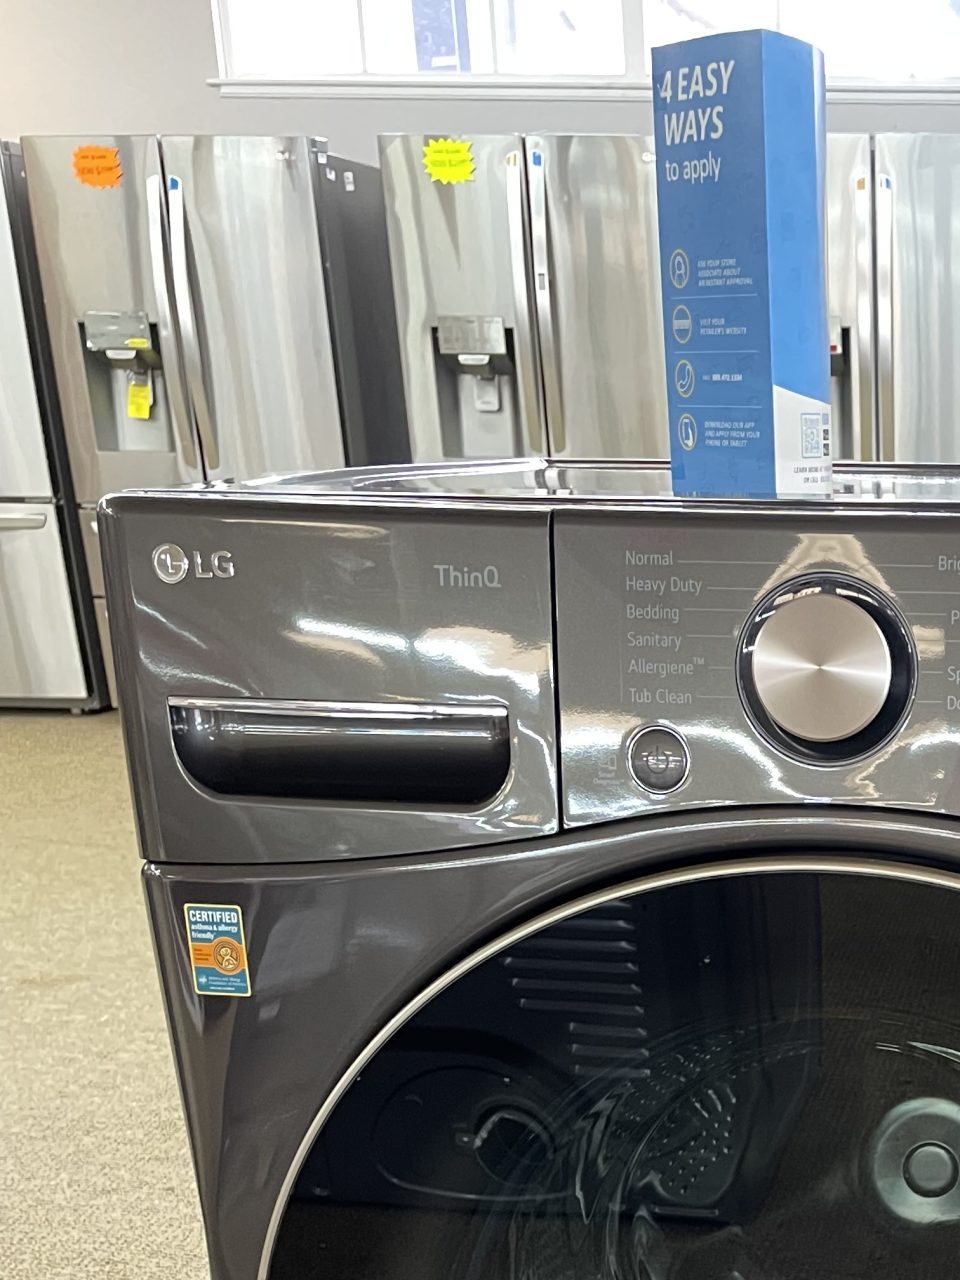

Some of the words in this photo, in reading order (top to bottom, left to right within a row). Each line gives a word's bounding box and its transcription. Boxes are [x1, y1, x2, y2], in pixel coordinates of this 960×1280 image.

[658, 70, 672, 103] 4
[678, 60, 735, 101] EASY
[664, 106, 724, 146] WAYS
[666, 160, 679, 182] to
[683, 151, 721, 184] apply
[193, 550, 235, 578] LG
[625, 550, 674, 566] Normal
[434, 565, 501, 588] ThinQ
[626, 576, 666, 595] Heavy
[670, 577, 702, 595] Duty
[626, 604, 680, 623] Bedding
[627, 632, 682, 651] Sanitary
[629, 688, 652, 704] Tub
[656, 689, 692, 705] Clean
[189, 909, 238, 924] CERTIFIED
